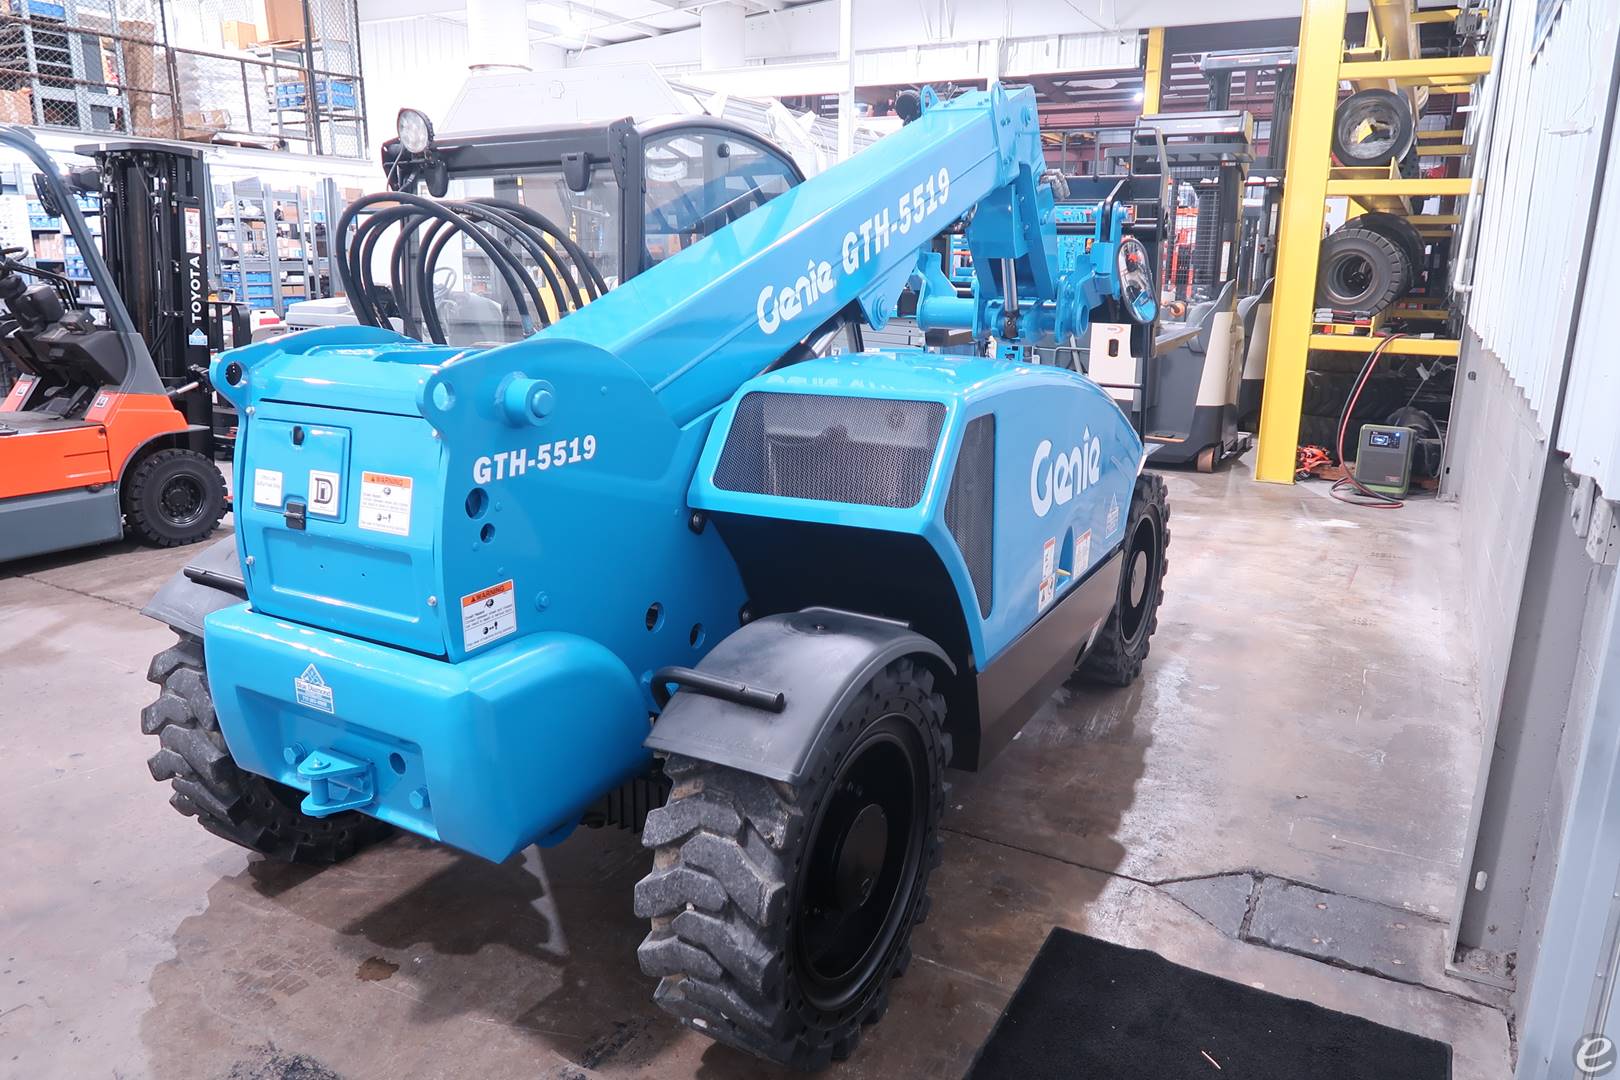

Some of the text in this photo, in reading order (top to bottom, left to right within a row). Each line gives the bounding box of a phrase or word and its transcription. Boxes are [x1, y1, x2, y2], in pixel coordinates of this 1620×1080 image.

[189, 255, 203, 324] TOYOTA
[757, 167, 951, 335] Genie GTH-5519
[472, 434, 597, 485] GTH-5519
[1030, 423, 1101, 518] Genie
